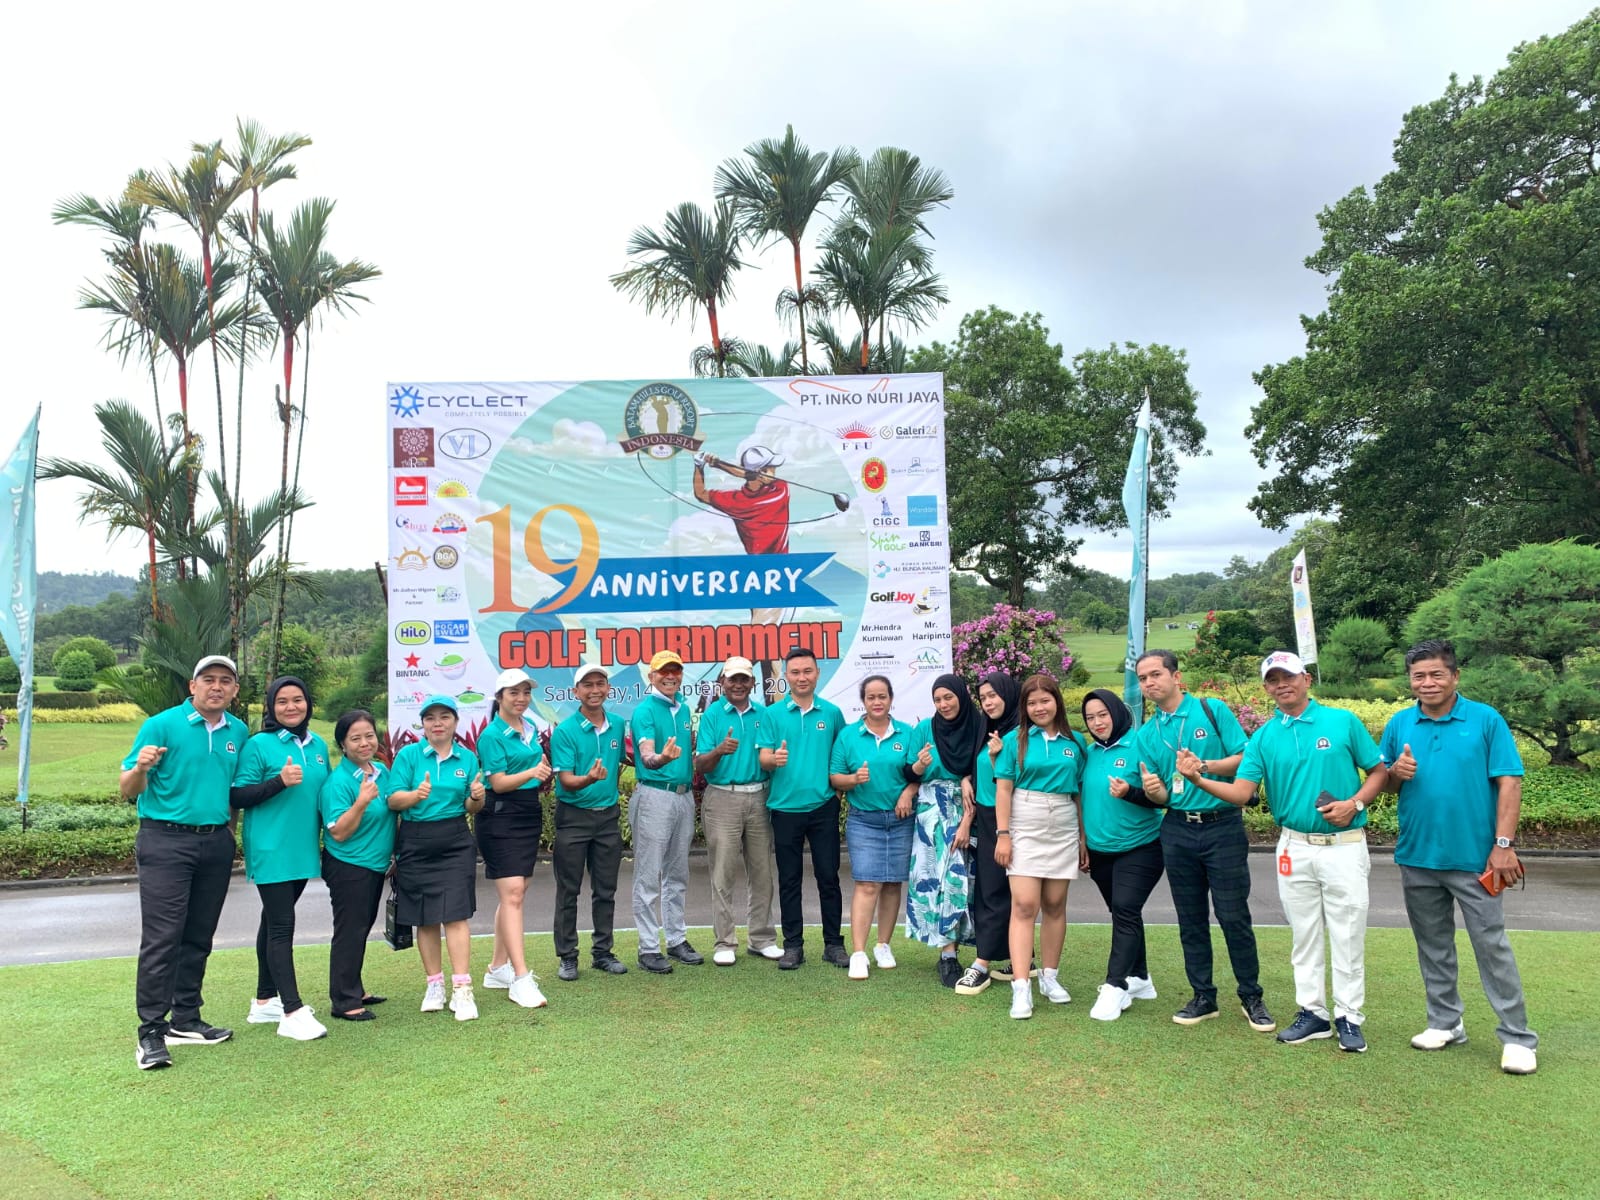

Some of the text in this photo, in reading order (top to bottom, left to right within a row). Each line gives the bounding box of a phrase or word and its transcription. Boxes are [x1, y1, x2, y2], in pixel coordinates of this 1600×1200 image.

[427, 396, 528, 407] CYCLECT
[800, 391, 940, 406] PT. INKO NURI JAYA
[681, 398, 695, 428] RESORT
[626, 434, 695, 451] INDONESIA
[872, 517, 900, 525] CIGC
[884, 543, 907, 552] GOLF
[475, 503, 600, 614] 19
[870, 591, 916, 604] GolfJoy
[924, 621, 938, 629] Mr.
[400, 626, 427, 638] HiLo
[912, 632, 951, 641] Haripinto
[498, 629, 588, 669] GOLF
[396, 670, 430, 678] BINTANG
